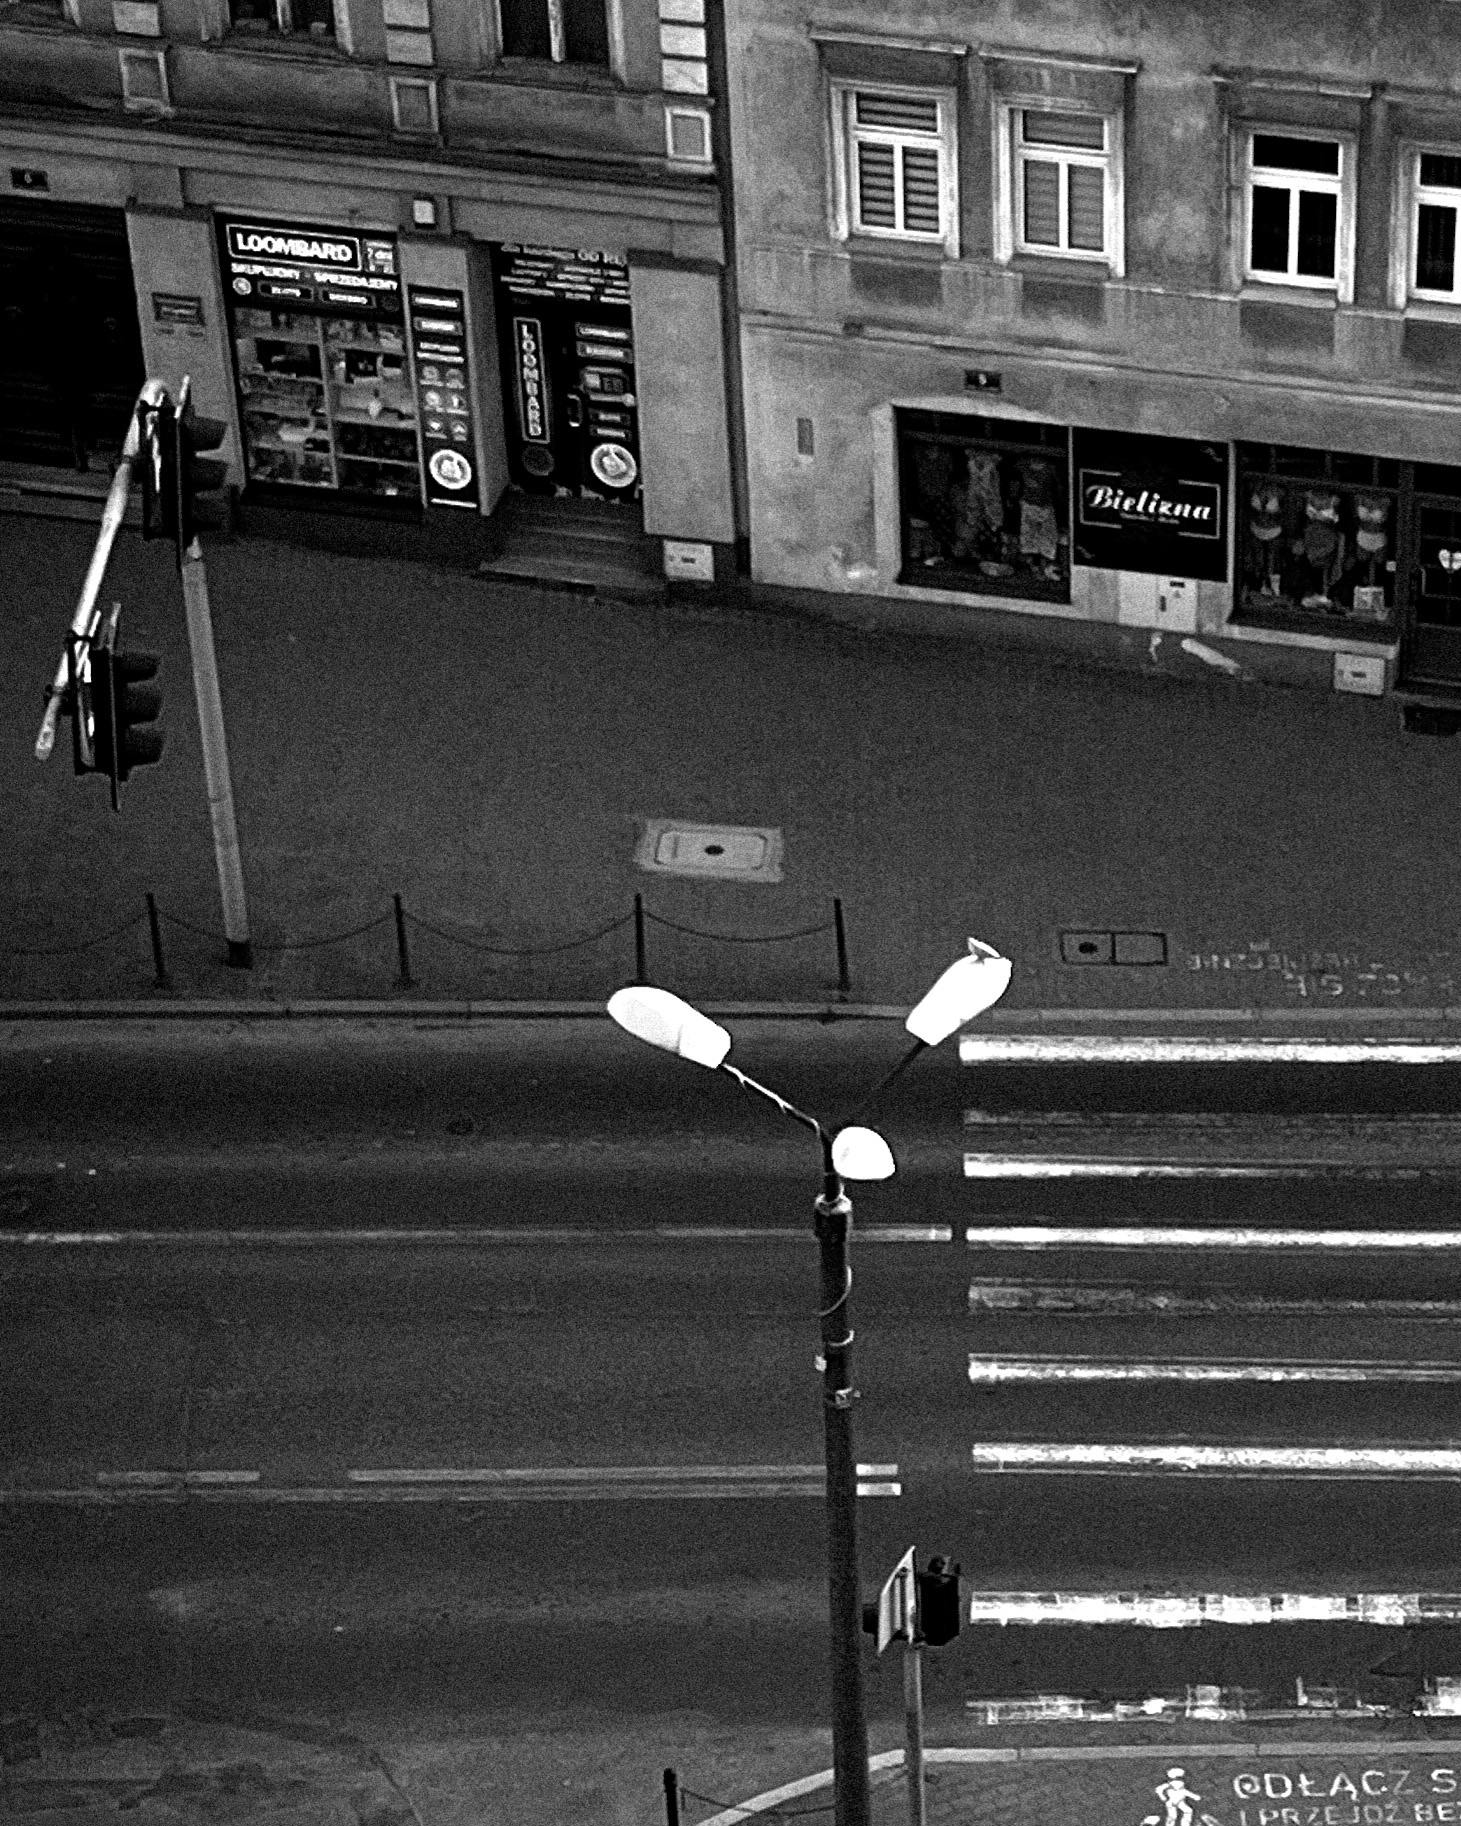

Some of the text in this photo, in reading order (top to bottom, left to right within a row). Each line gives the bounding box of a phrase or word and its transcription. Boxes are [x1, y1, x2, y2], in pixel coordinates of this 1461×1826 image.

[237, 233, 352, 262] LOOMBARD
[522, 324, 542, 436] LOOMBARD
[1086, 485, 1211, 520] Bielizna
[1259, 1800, 1404, 1826] PRZEJDŹ
